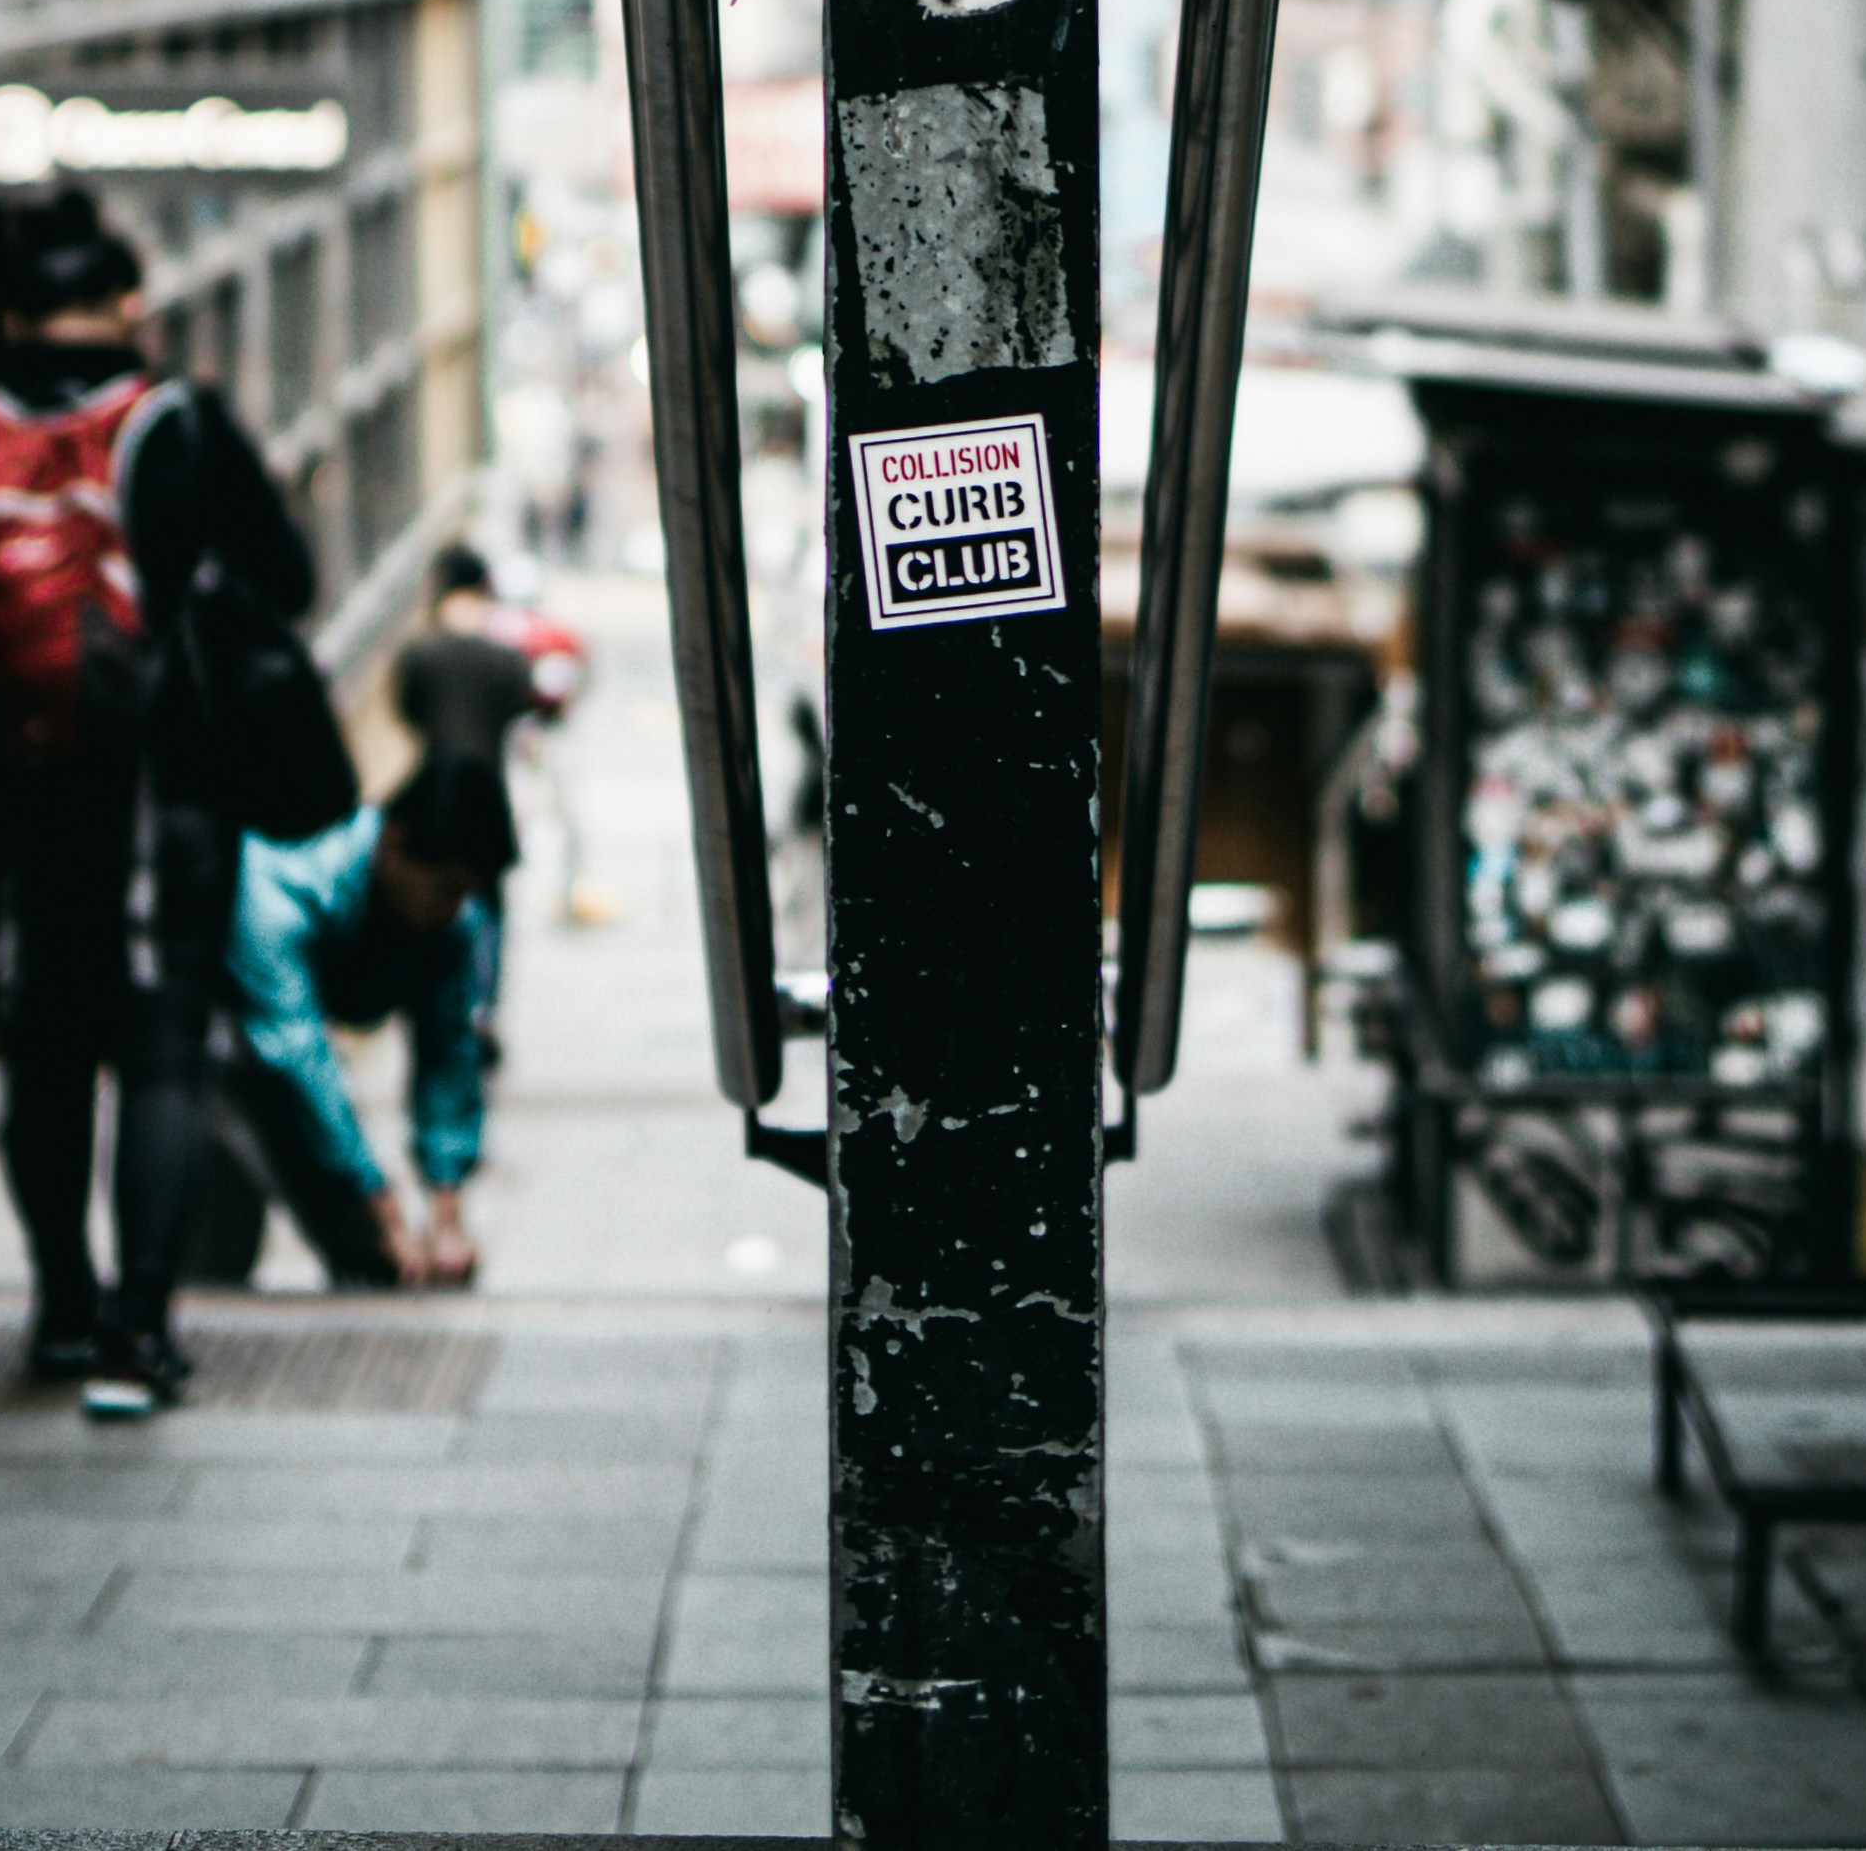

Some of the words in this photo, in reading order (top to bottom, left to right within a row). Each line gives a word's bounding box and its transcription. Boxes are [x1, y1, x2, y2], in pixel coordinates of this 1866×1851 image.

[881, 441, 1021, 484] COLLISION
[887, 480, 1026, 531] CURB
[896, 539, 1031, 592] CLUB
